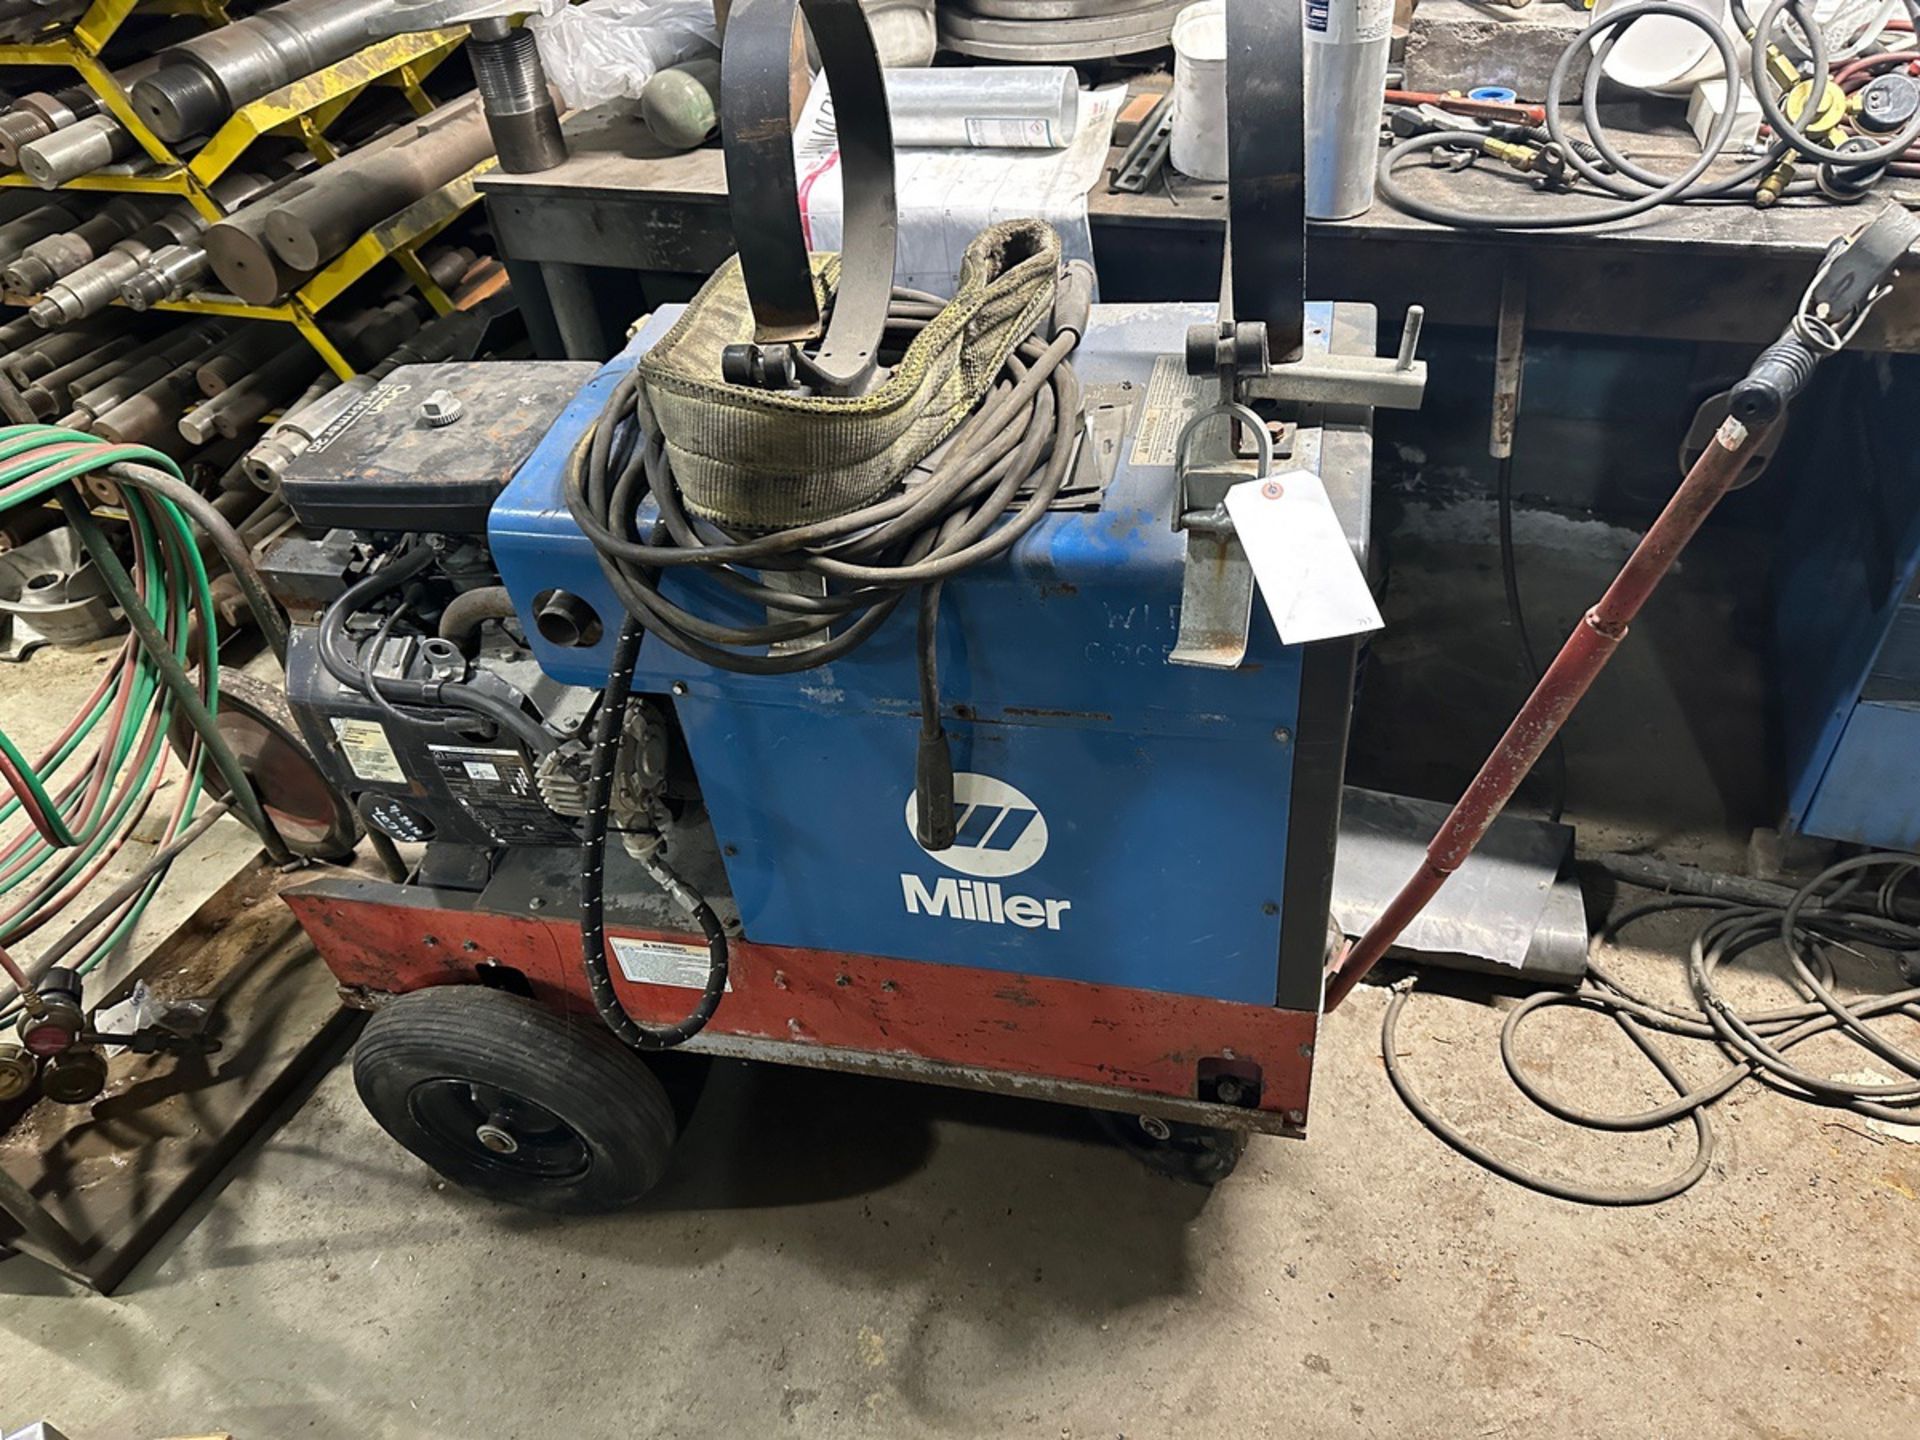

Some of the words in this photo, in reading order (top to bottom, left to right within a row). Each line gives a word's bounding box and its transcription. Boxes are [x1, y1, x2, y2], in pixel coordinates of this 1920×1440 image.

[366, 384, 412, 415] Onan
[306, 436, 329, 452] 20
[900, 873, 1071, 930] Miller
